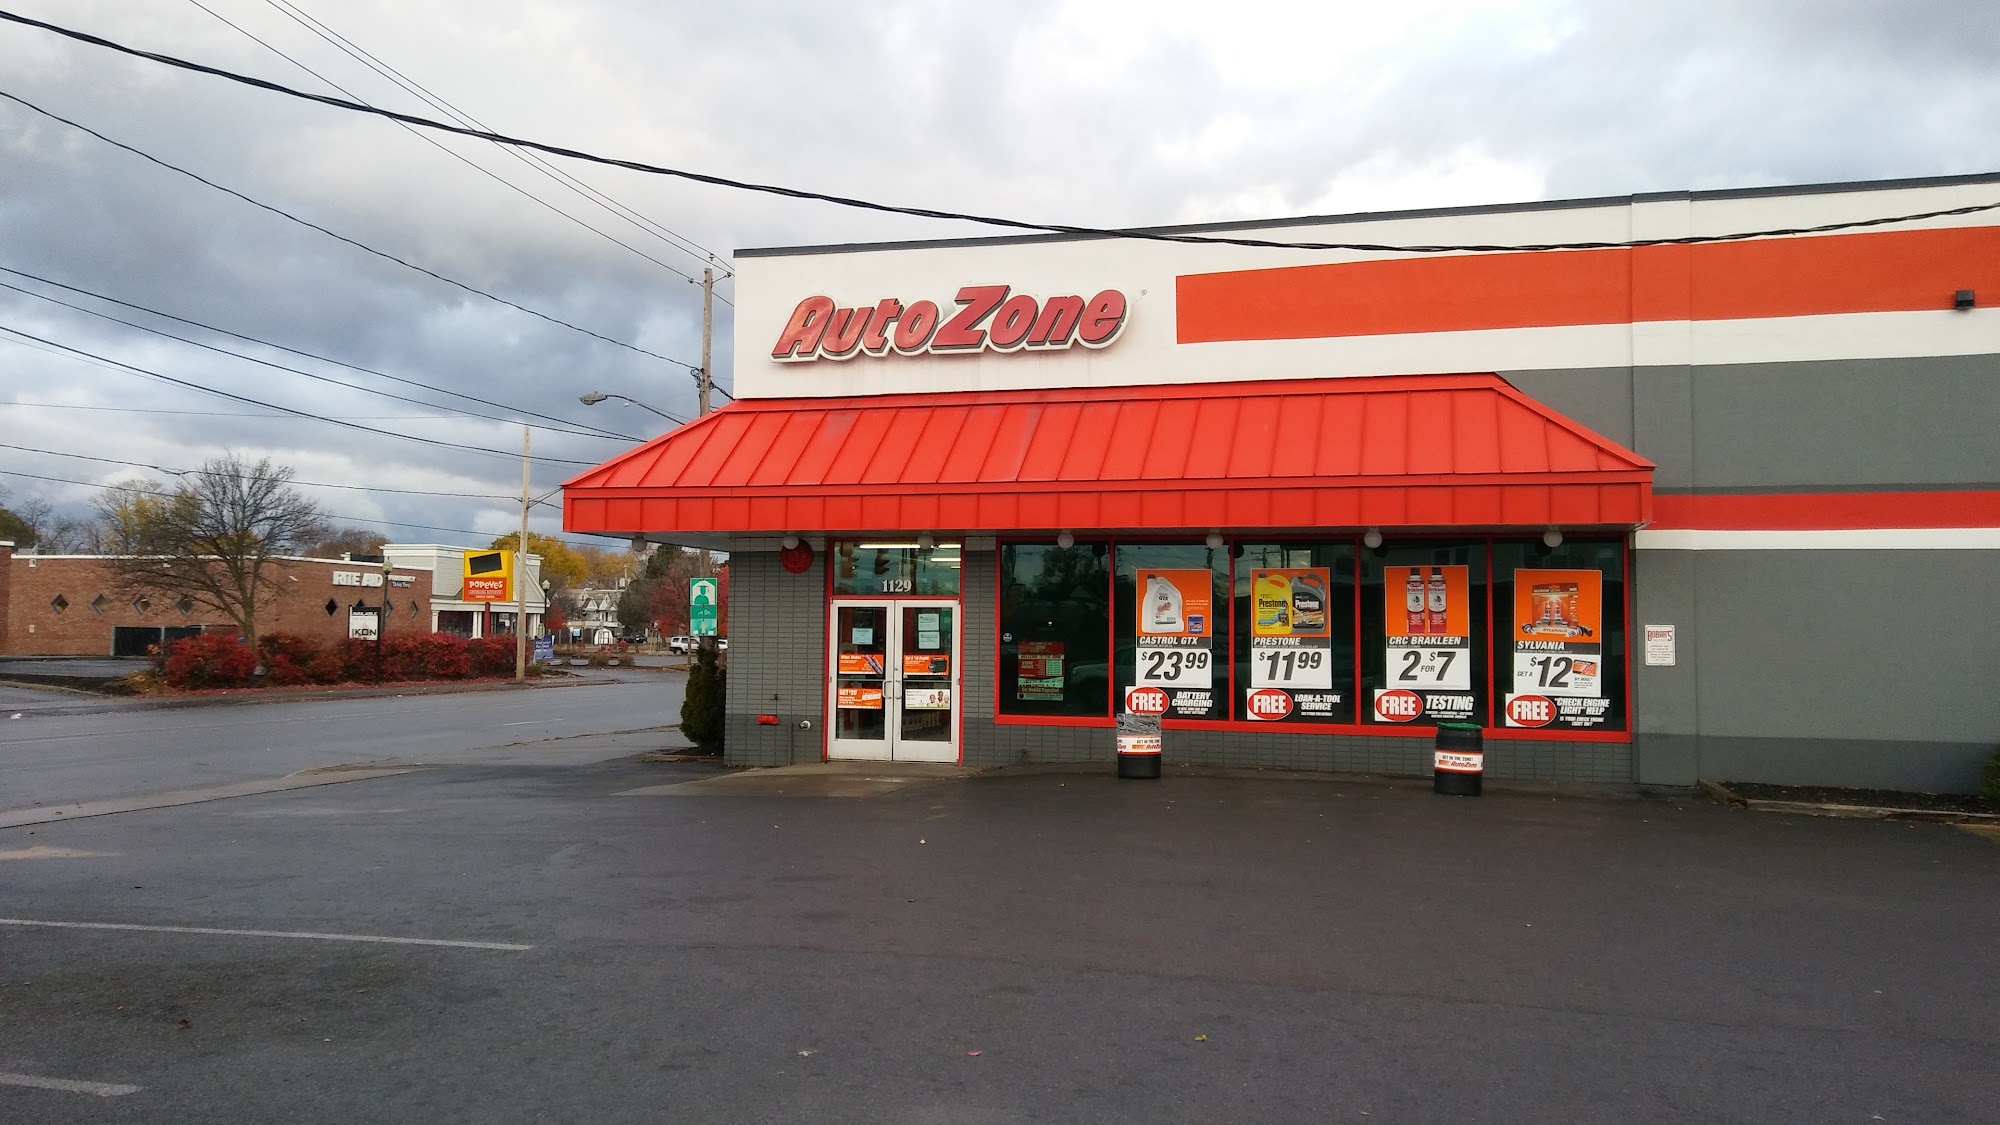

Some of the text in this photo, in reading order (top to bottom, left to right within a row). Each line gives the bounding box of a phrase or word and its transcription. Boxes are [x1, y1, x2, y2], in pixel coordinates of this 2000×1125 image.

[770, 284, 1129, 361] AutoZone
[333, 571, 384, 588] RITE AID
[882, 579, 912, 593] 1129
[1258, 599, 1286, 608] Prestone
[1295, 600, 1320, 609] Prestone
[351, 628, 377, 636] IKON
[1140, 636, 1199, 645] CASTROL GTX
[1254, 637, 1302, 646] PRESTONE
[1389, 636, 1462, 645] CRC BRAKLEEN
[1517, 641, 1565, 650] SYLVANIA
[1399, 650, 1421, 681] 2
[1420, 665, 1435, 673] FOR
[1176, 691, 1211, 700] BATTERY
[1294, 694, 1341, 703] LOAN-A-TOOL
[1131, 692, 1163, 711] FREE
[1171, 699, 1213, 707] CHARGING
[1253, 694, 1287, 714] FREE
[1381, 695, 1417, 716] FREE
[1425, 695, 1475, 711] TESTING
[1583, 699, 1610, 708] ENGINE
[1301, 702, 1332, 711] SERVICE
[1512, 700, 1549, 721] FREE
[1586, 707, 1605, 715] HELP
